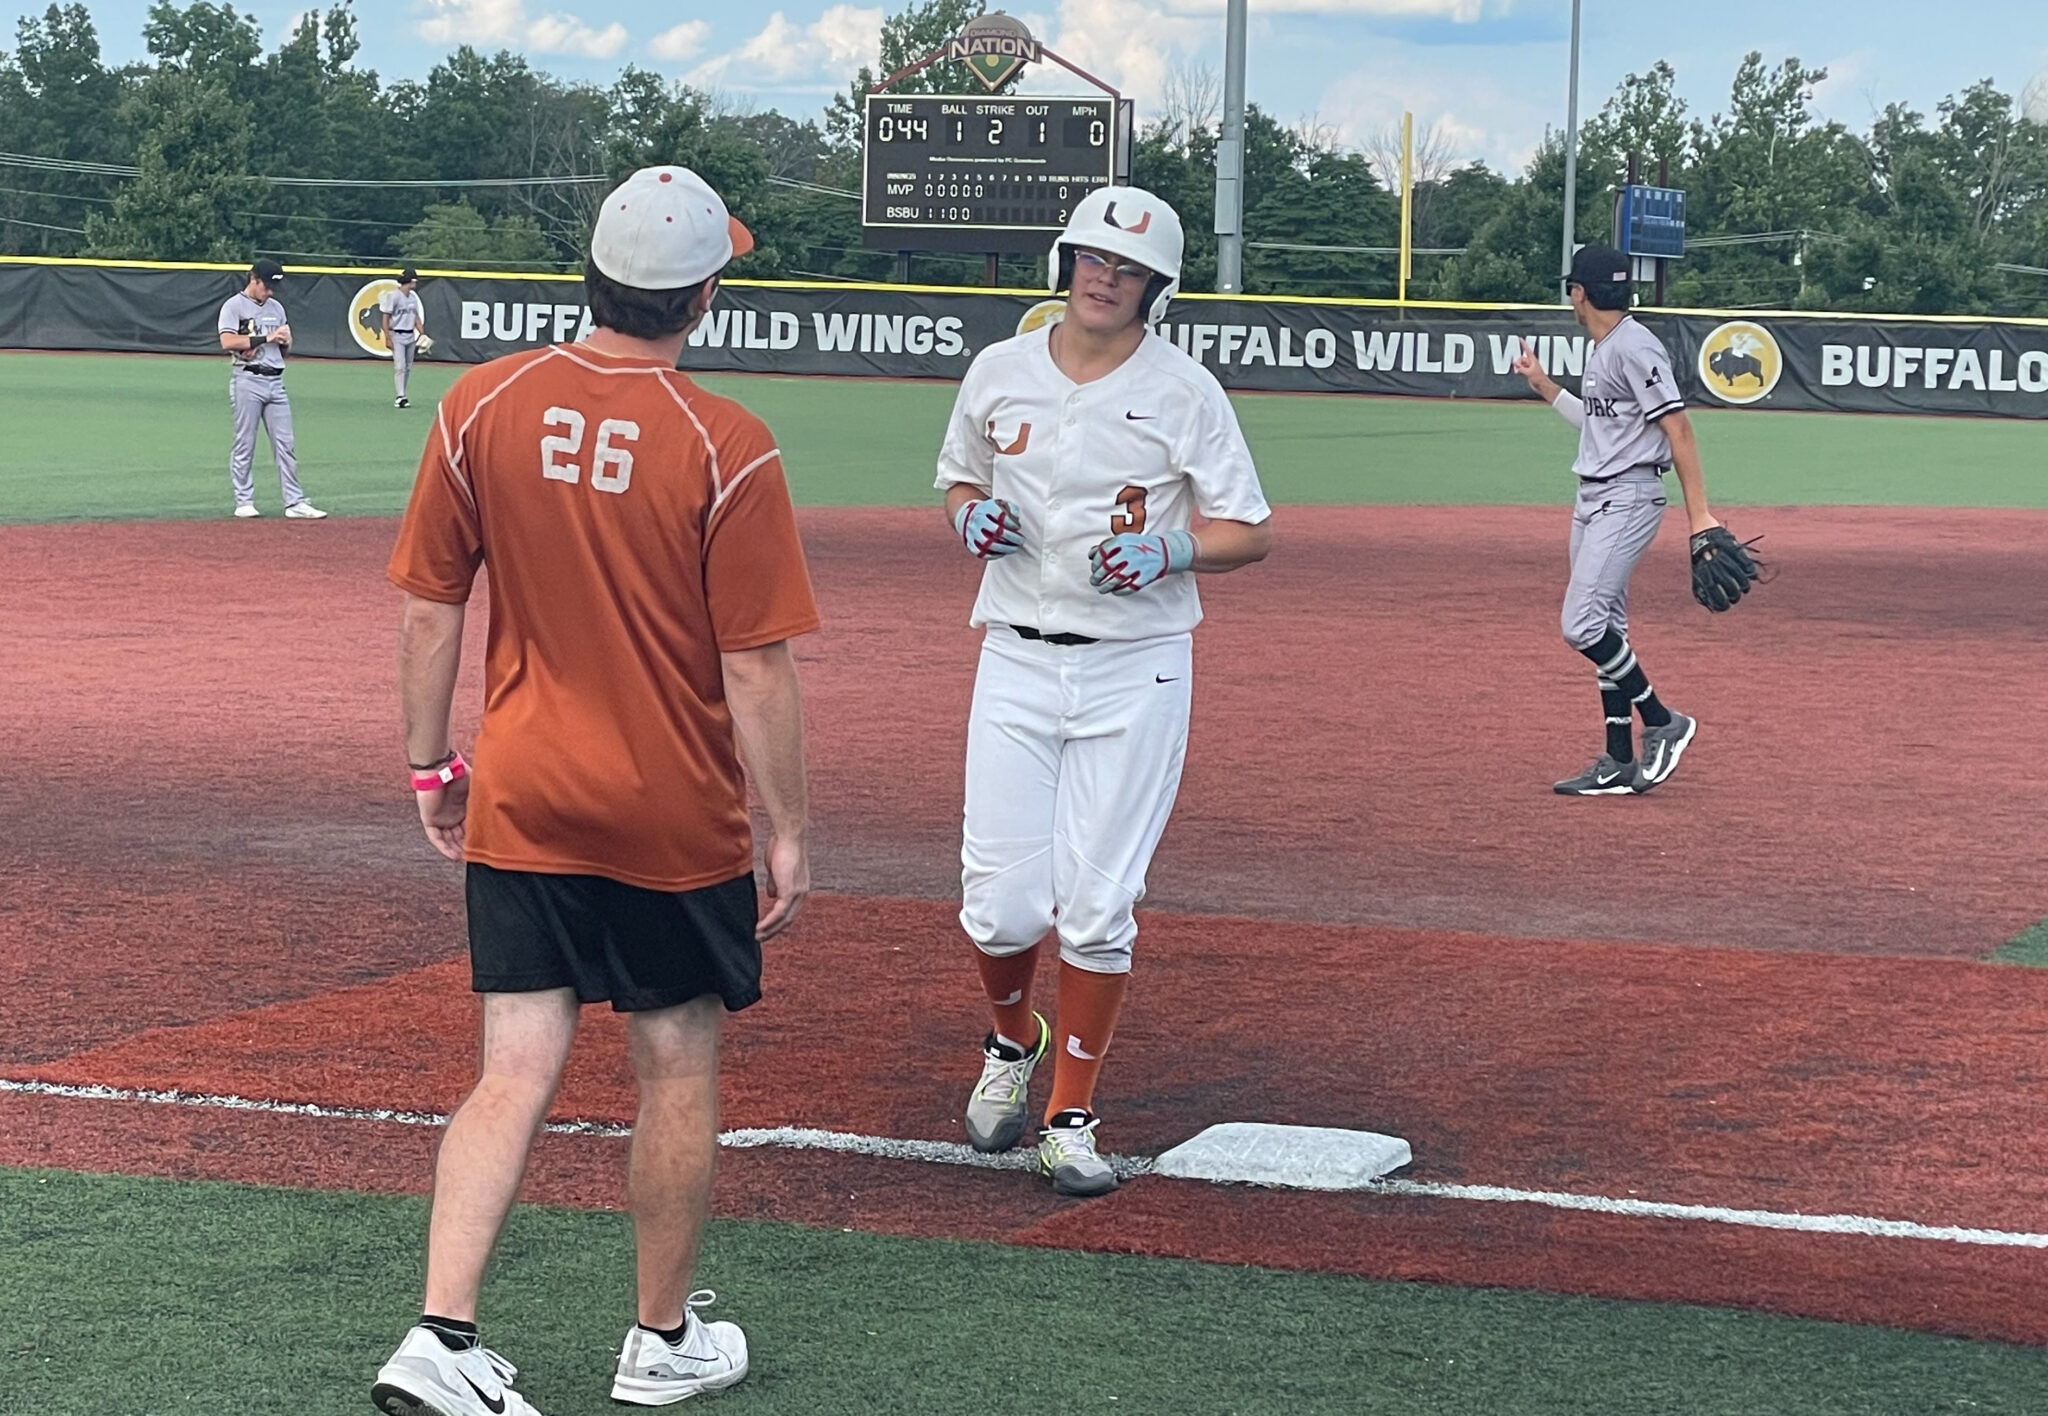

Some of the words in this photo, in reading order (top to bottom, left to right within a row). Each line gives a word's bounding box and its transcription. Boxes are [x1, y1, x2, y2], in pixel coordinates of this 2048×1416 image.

[951, 37, 1035, 60] NATION
[887, 104, 912, 114] TIME
[941, 105, 967, 115] BALL
[976, 105, 1015, 116] STRIKE
[1025, 105, 1049, 116] OUT
[1072, 106, 1097, 116] MPH
[957, 121, 962, 142] 1
[988, 120, 1003, 145] 2
[1040, 122, 1045, 143] 1
[1089, 121, 1104, 146] 0
[887, 184, 914, 195] MVP
[886, 207, 919, 219] BSBU
[687, 310, 800, 350] WILD
[812, 312, 964, 357] WINGS
[1152, 323, 1336, 369] UFFALO
[1351, 330, 1475, 374] WILD
[1488, 334, 1594, 377] WIN
[1821, 344, 2048, 393] BUFFALO
[541, 406, 640, 494] 26
[1110, 485, 1148, 536] 3
